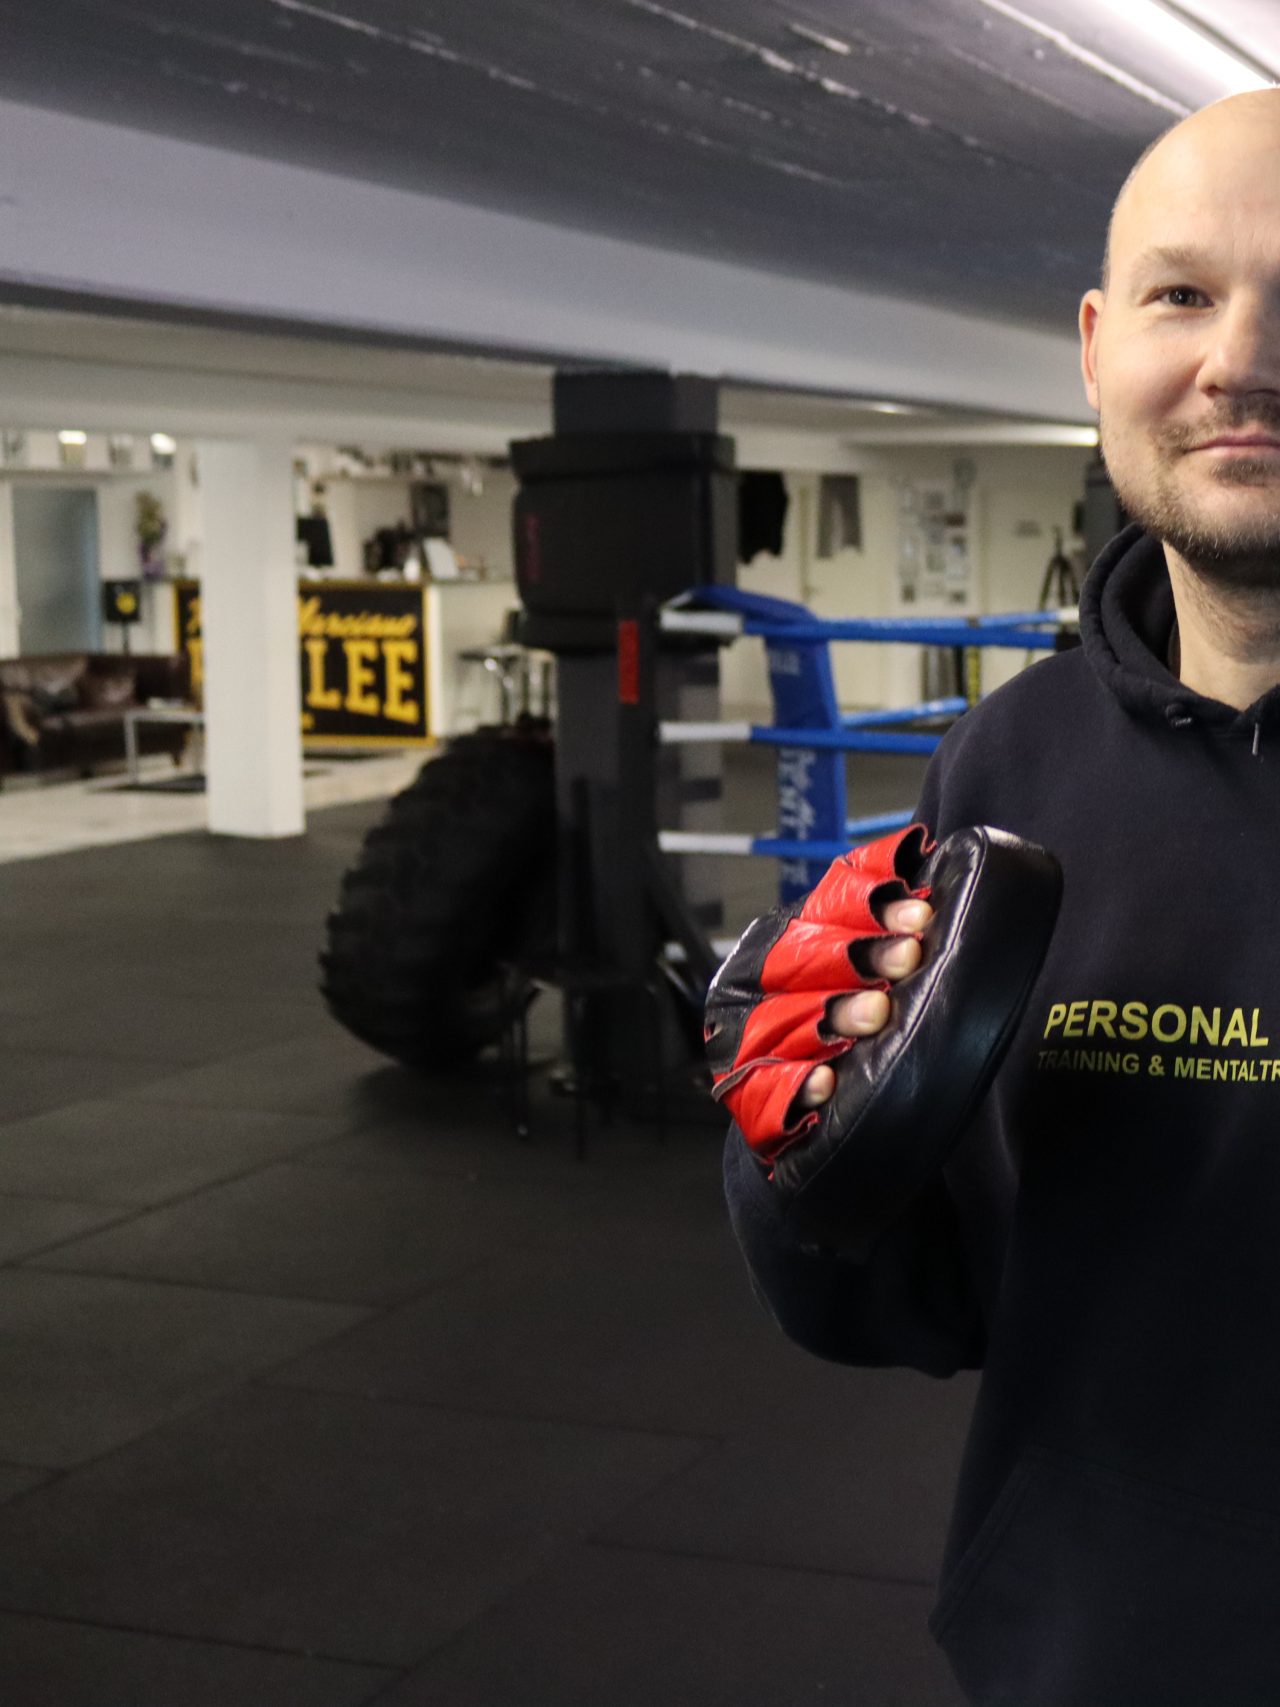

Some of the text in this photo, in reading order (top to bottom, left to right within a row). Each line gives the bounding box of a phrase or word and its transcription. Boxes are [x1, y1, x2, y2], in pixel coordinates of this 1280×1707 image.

[1043, 1000, 1269, 1047] PERSONAL
[1037, 1050, 1140, 1075] TRAINING
[1147, 1054, 1166, 1077] &
